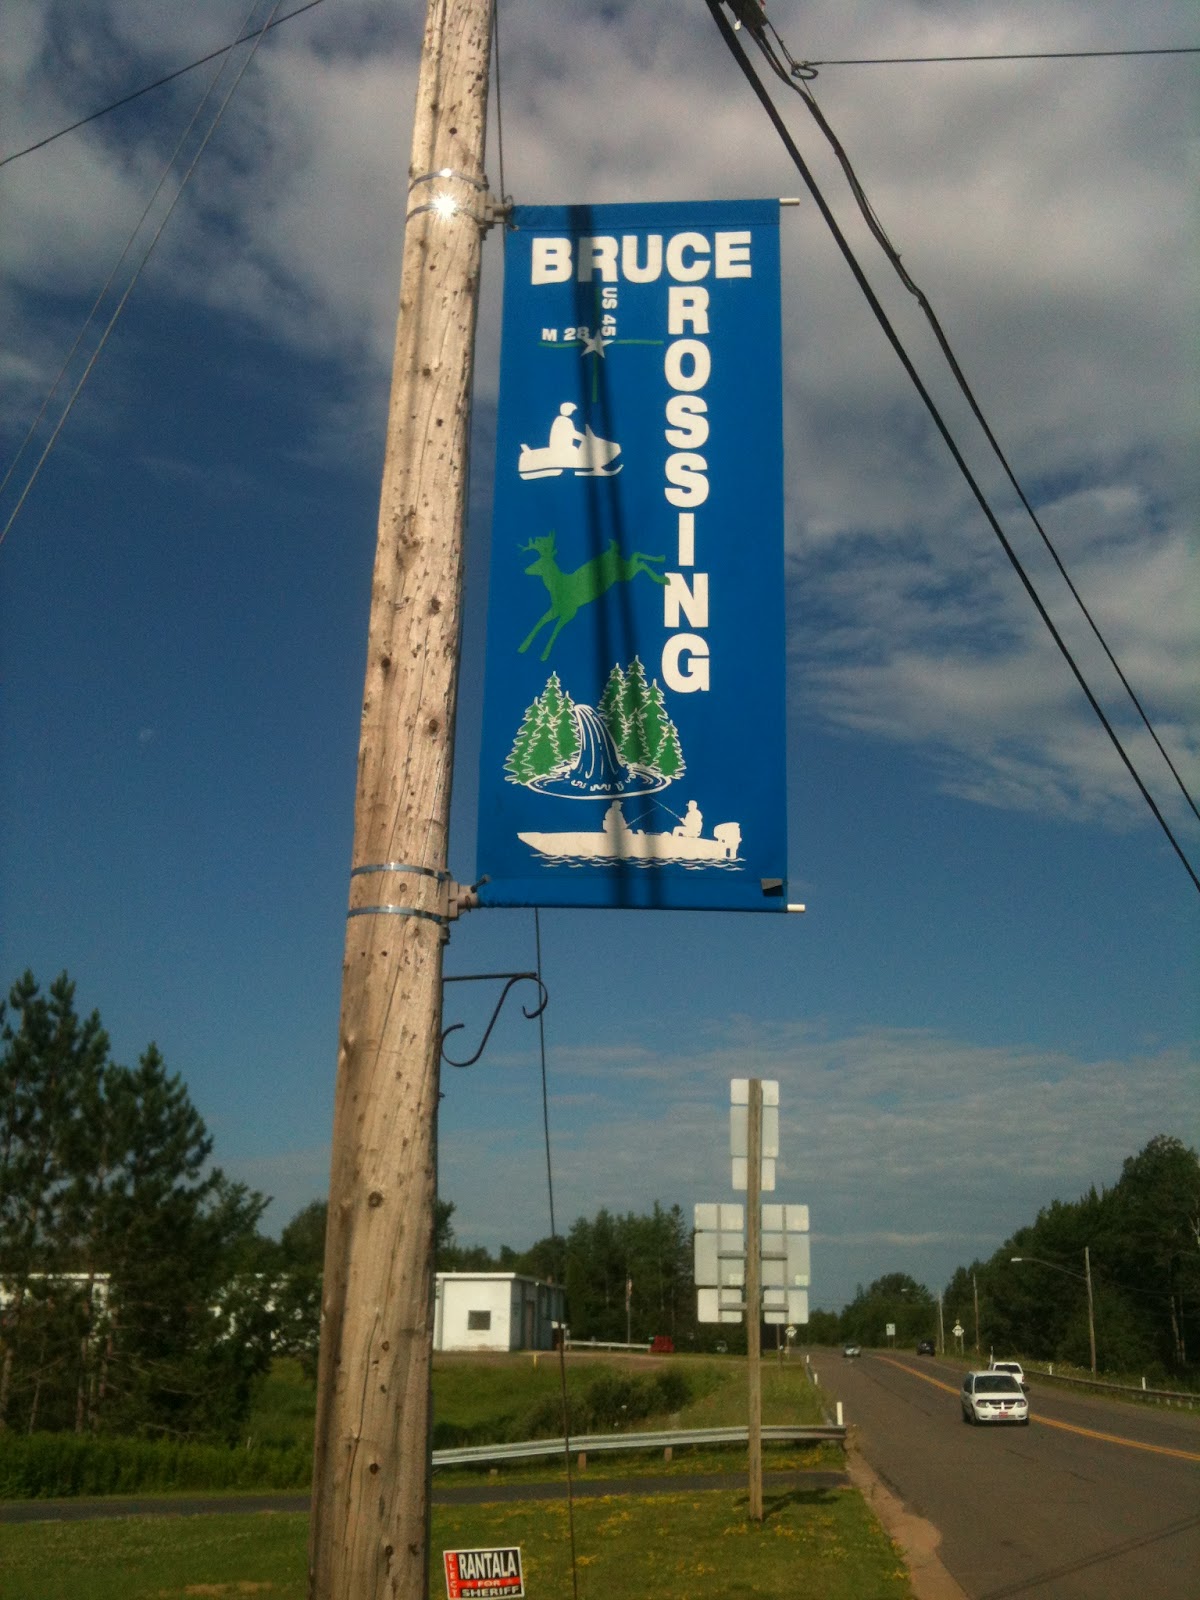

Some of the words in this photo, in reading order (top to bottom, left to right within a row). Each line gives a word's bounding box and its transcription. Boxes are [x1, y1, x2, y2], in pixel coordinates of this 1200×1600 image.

[531, 231, 752, 285] BRUCE
[601, 287, 618, 309] US
[541, 328, 558, 342] M
[563, 326, 590, 341] 28
[601, 314, 617, 336] 45
[448, 1554, 458, 1597] ELECT
[459, 1552, 517, 1579] RANTALA
[462, 1585, 519, 1597] SHERIFF
